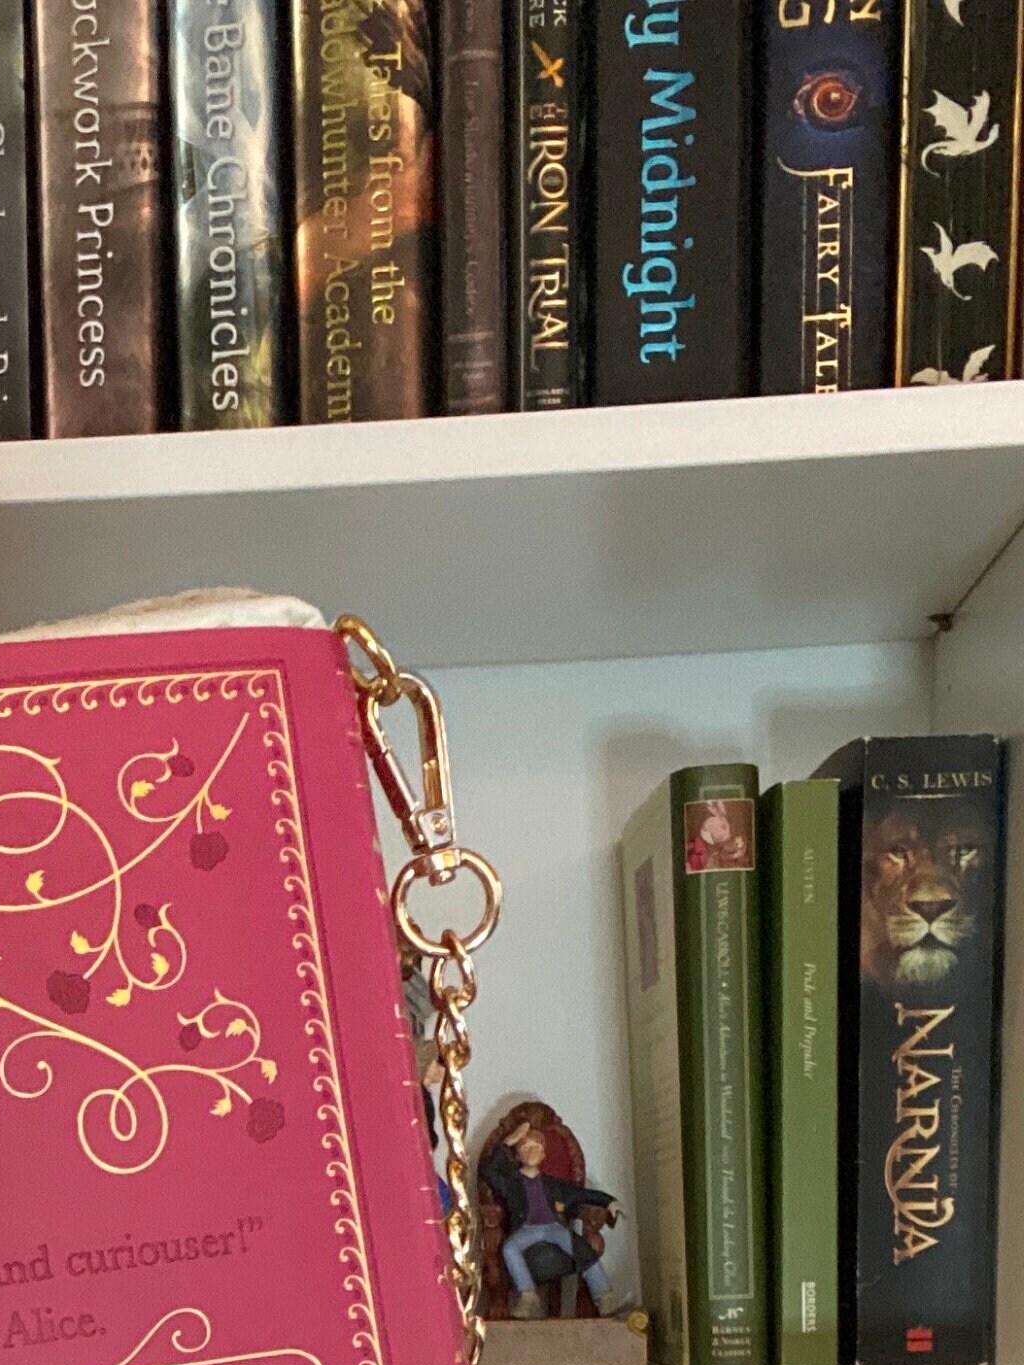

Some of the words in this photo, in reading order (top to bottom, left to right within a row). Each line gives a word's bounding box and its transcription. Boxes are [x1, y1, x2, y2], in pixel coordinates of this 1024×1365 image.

[204, 22, 244, 139] Bane
[368, 41, 402, 141] Tales
[368, 152, 404, 251] from
[527, 125, 570, 235] IRON
[623, 68, 697, 364] Midnight
[777, 156, 854, 286] FAIRY
[77, 201, 114, 388] Princess
[207, 156, 252, 413] Chronicles
[370, 259, 407, 327] the
[528, 243, 571, 374] TRIAL
[923, 770, 993, 789] LEWIS
[884, 1002, 955, 1266] NARNIA
[2, 1309, 107, 1349] Alice.
[806, 1281, 816, 1333] BORDERS
